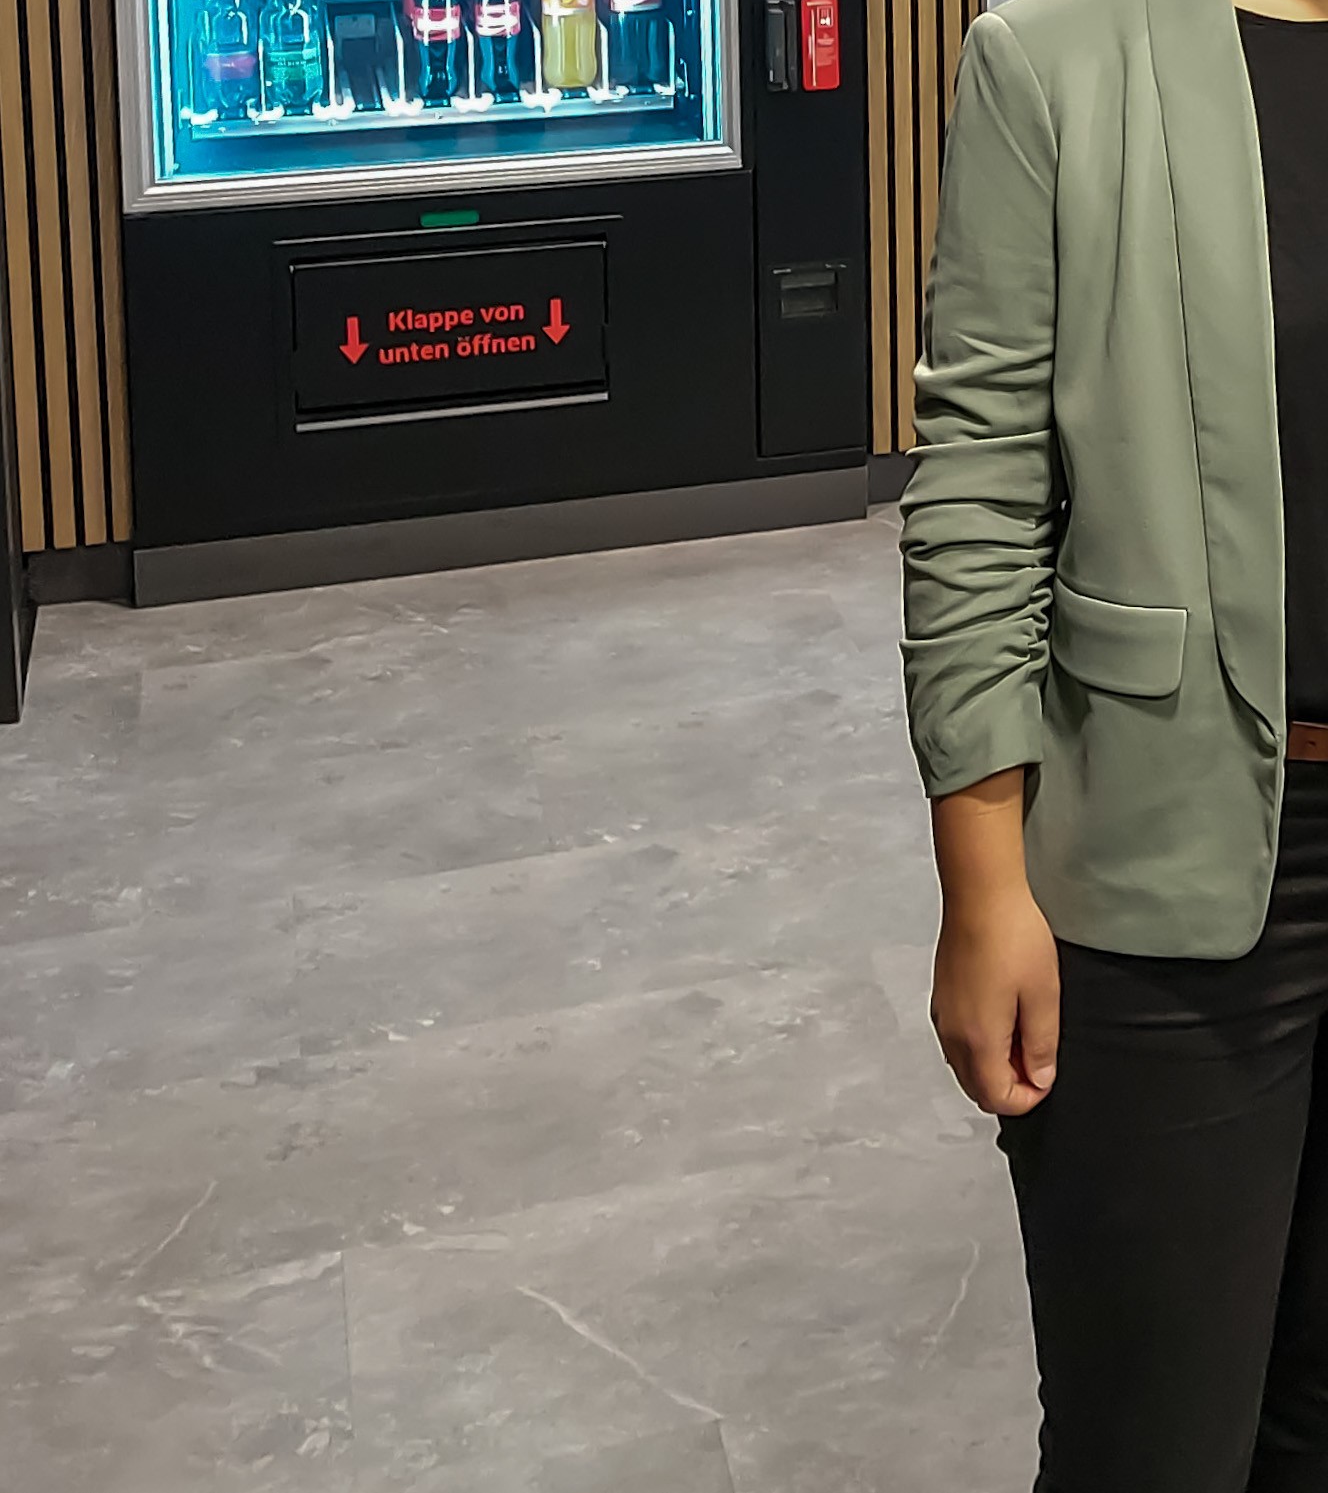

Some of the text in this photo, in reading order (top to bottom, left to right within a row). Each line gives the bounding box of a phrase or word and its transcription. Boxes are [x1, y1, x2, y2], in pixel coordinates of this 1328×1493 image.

[388, 304, 525, 333] Klappe von
[379, 333, 536, 365] unten öffnen
